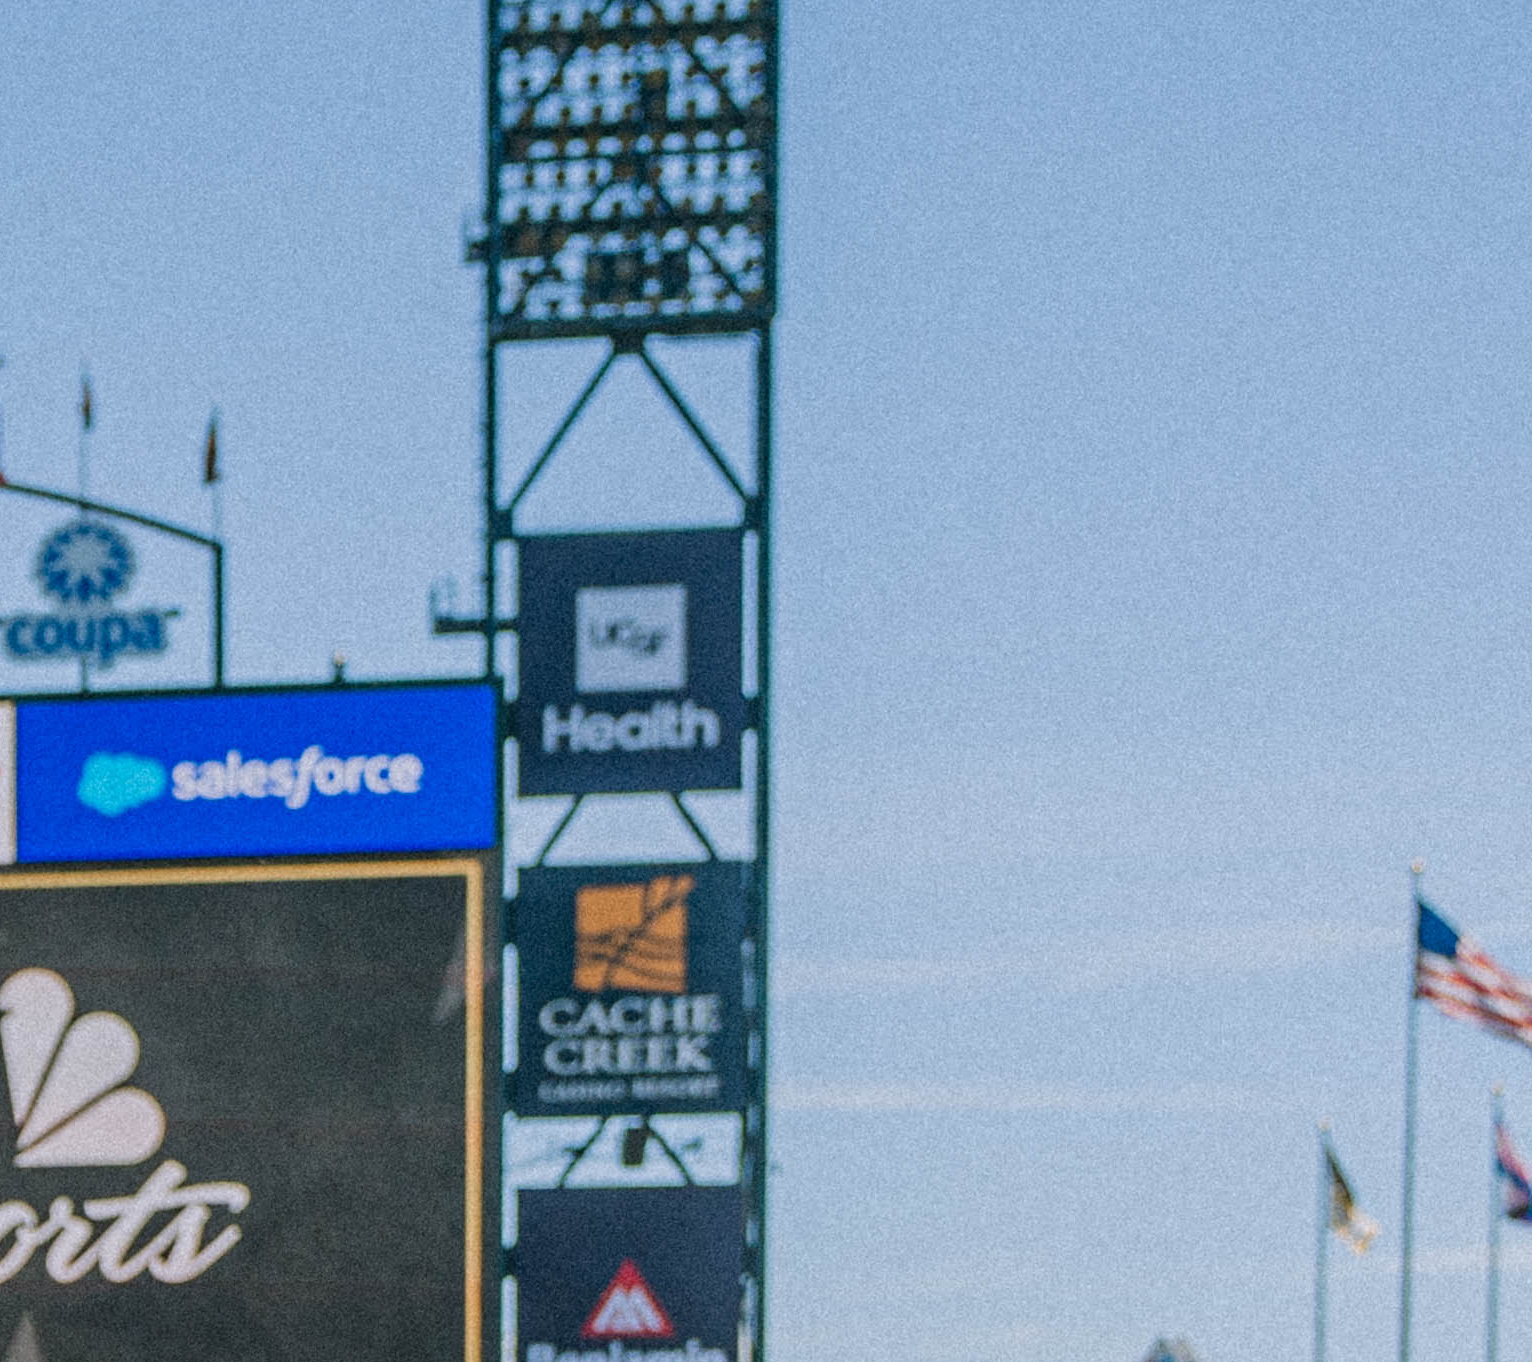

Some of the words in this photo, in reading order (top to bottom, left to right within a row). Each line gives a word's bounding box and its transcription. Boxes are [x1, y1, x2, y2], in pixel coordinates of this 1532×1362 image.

[3, 606, 171, 669] coupa
[542, 700, 721, 752] Health
[171, 744, 424, 809] salesforce
[538, 994, 721, 1037] CACHE
[542, 1035, 714, 1077] CREEK
